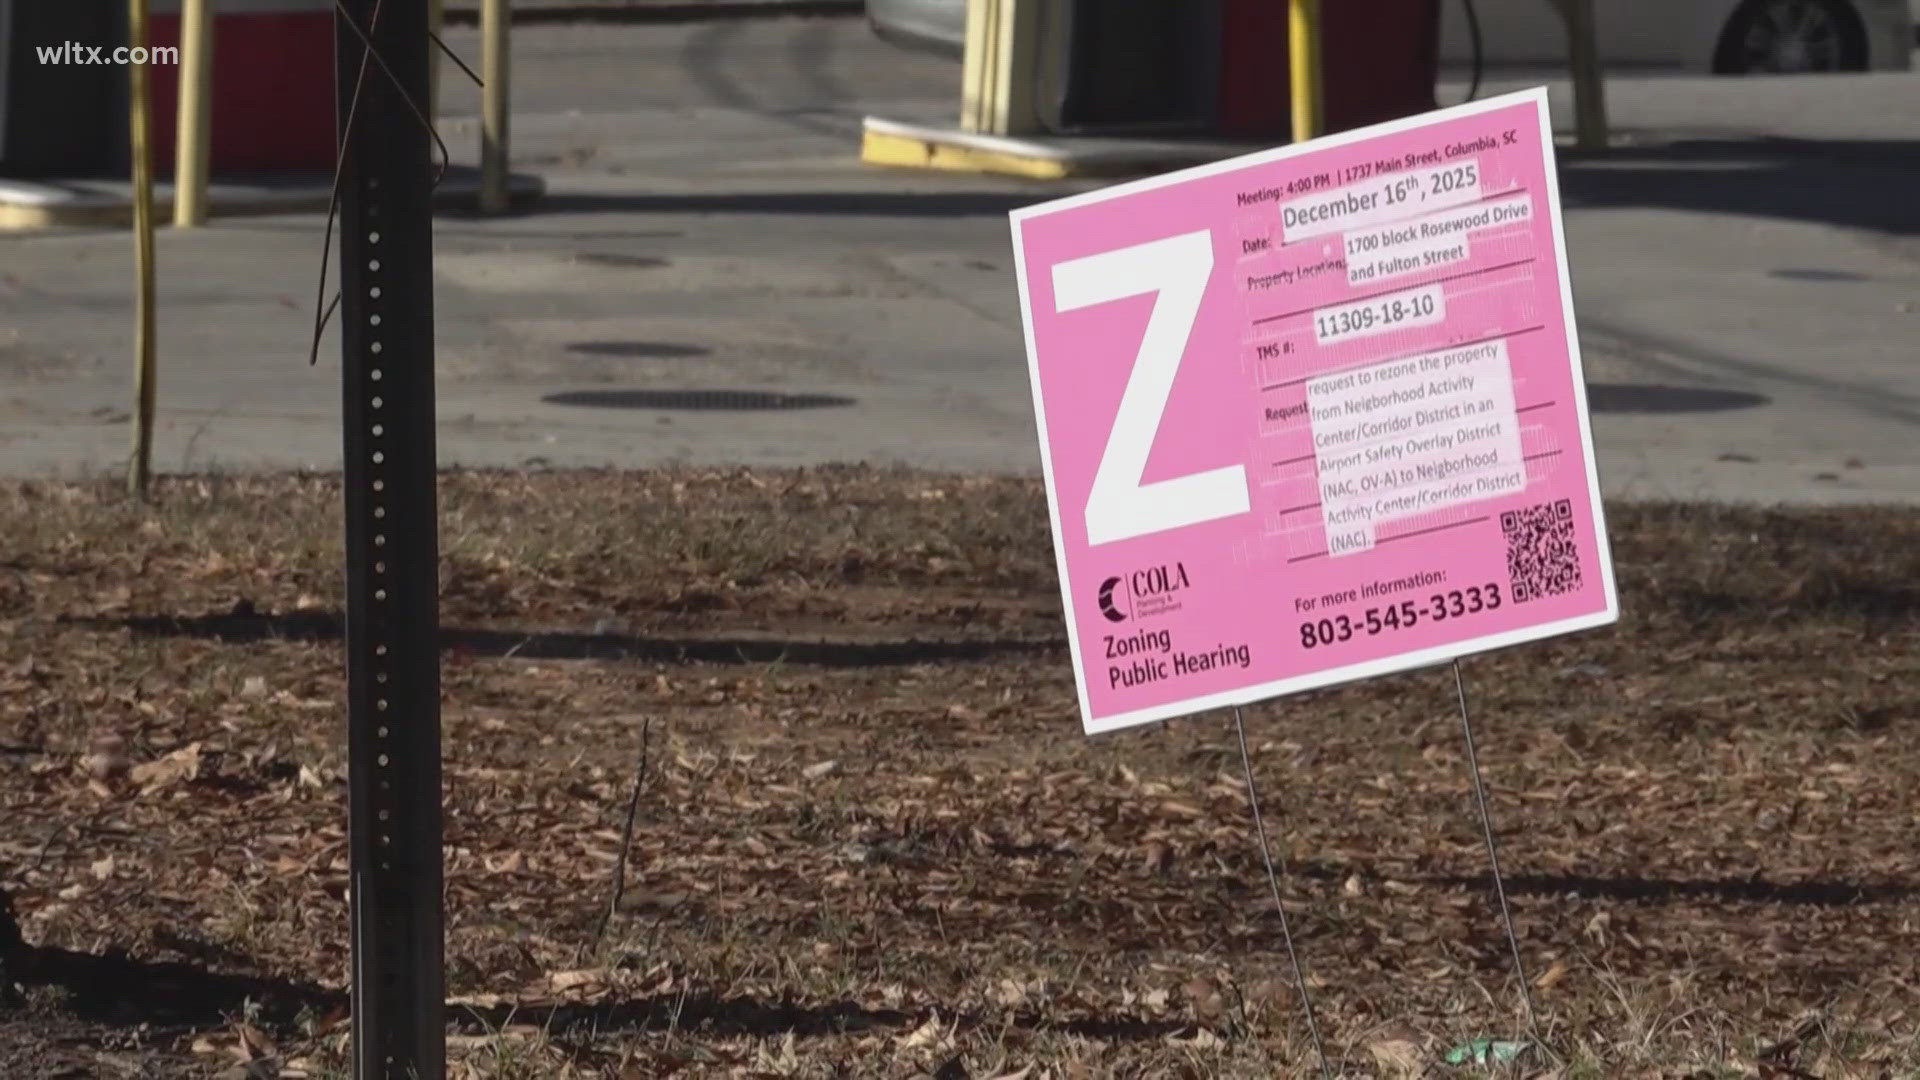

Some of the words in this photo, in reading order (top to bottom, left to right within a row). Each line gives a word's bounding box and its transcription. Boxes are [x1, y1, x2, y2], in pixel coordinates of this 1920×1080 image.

[1236, 187, 1284, 207] Meeting:
[1286, 177, 1312, 195] 4:00
[1313, 173, 1331, 188] PM
[1345, 163, 1372, 183] 1737
[1375, 157, 1402, 175] Main
[1404, 150, 1442, 168] Street,
[1444, 136, 1501, 158] Columbia,
[1502, 129, 1518, 145] SC
[1283, 191, 1379, 229] December
[1384, 175, 1426, 205] 16th,
[1430, 165, 1478, 195] 2025
[1242, 238, 1271, 254] Date:
[1347, 234, 1379, 255] 1700
[1382, 227, 1418, 247] block
[1420, 210, 1490, 239] Rosewood
[1493, 203, 1528, 223] Drive
[1247, 270, 1294, 291] Property
[1350, 263, 1375, 282] and
[1378, 255, 1421, 276] Fulton
[1424, 245, 1464, 266] Street
[1317, 294, 1435, 338] 11309-18-10
[1256, 343, 1280, 360] TMS
[1308, 373, 1355, 396] request
[1358, 370, 1372, 386] to
[1374, 361, 1417, 382] rezone
[1419, 355, 1441, 373] the
[1444, 344, 1499, 370] property
[1051, 229, 1251, 547] Z
[1311, 404, 1342, 422] from
[1344, 382, 1426, 415] Neigborhood
[1428, 376, 1475, 397] Activity
[1315, 415, 1413, 448] Center/Corridor
[1415, 404, 1461, 427] District
[1463, 400, 1476, 416] in
[1478, 398, 1495, 413] an
[1319, 453, 1362, 475] Airport
[1365, 444, 1403, 464] Safety
[1405, 434, 1454, 454] Overlay
[1456, 422, 1502, 444] District
[1323, 478, 1359, 504] (NAC,
[1360, 469, 1398, 491] OV-A)
[1400, 469, 1414, 483] to
[1416, 448, 1499, 479] Neigborhood
[1327, 503, 1373, 526] Activity
[1375, 482, 1474, 515] Center/Corridor
[1476, 472, 1522, 492] District
[1330, 530, 1371, 554] (NAC).
[1132, 561, 1190, 598] COLA
[1294, 597, 1318, 614] For
[1321, 588, 1357, 608] more
[1360, 569, 1448, 599] information:
[1299, 582, 1502, 650] 803-545-3333
[1103, 628, 1172, 660] Zoning
[1109, 657, 1169, 691] Public
[1172, 643, 1252, 677] Hearing
